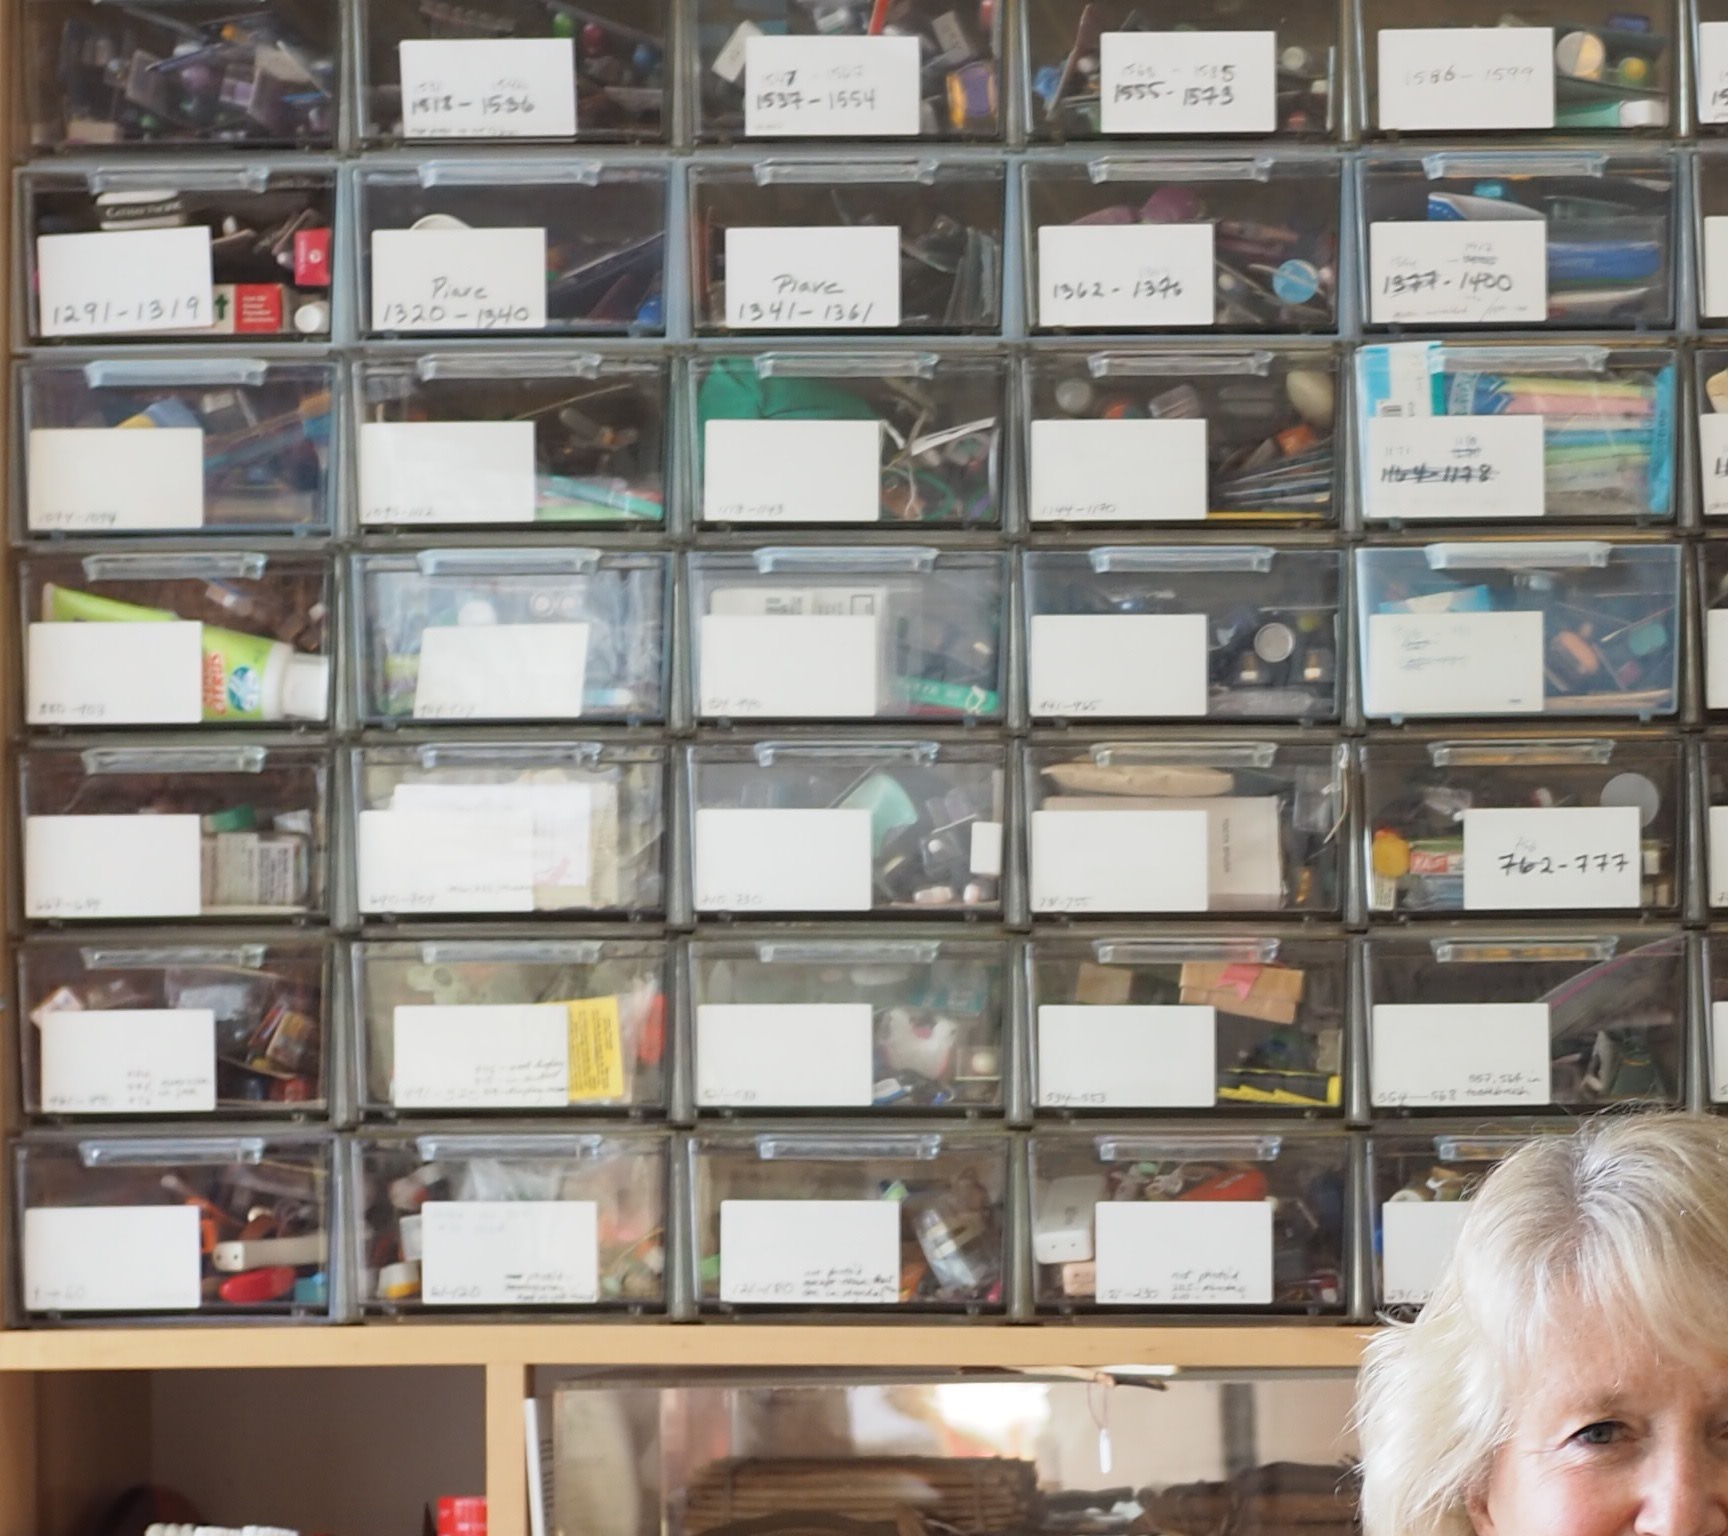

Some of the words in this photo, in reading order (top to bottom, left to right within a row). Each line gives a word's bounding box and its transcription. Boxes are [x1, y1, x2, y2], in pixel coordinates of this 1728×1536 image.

[756, 89, 876, 111] 1537-1554
[1113, 80, 1235, 106] 1555-1573
[52, 295, 202, 325] 1291-1319
[380, 303, 531, 330] 1320-1340
[738, 300, 874, 323] 1341-1361
[1497, 852, 1629, 876] 762-777
